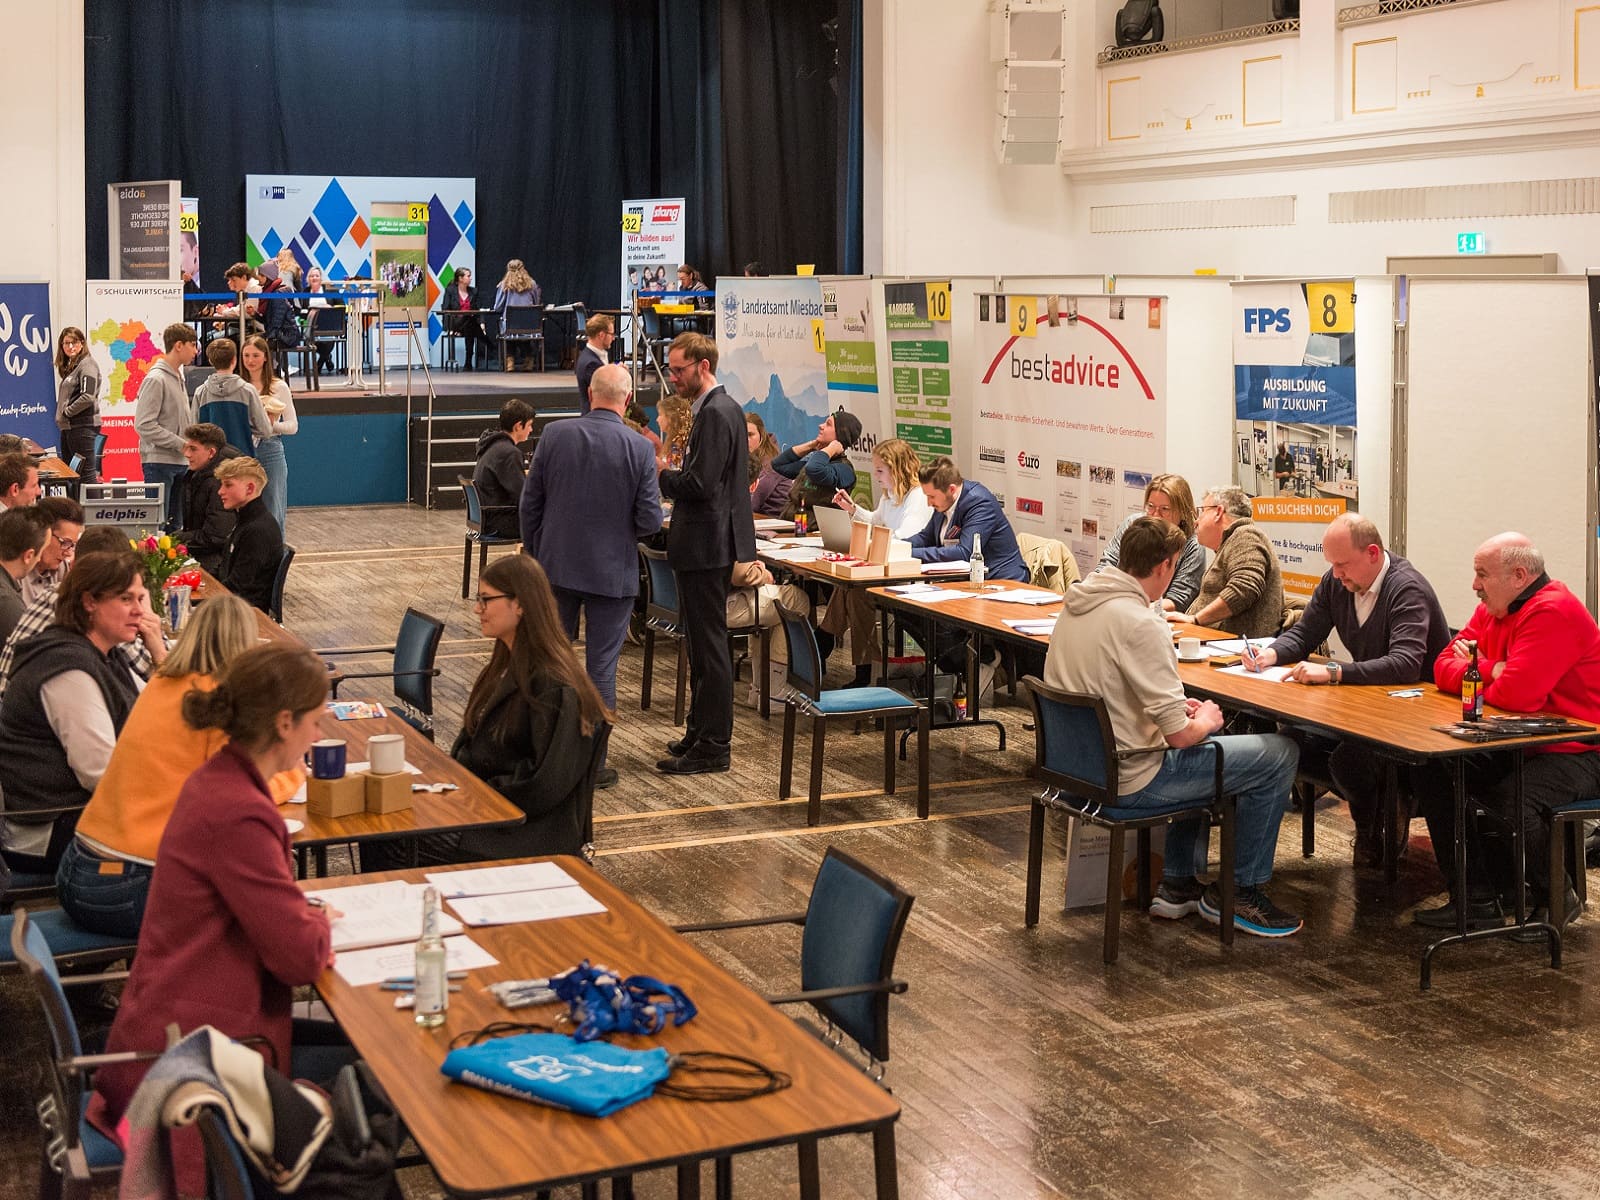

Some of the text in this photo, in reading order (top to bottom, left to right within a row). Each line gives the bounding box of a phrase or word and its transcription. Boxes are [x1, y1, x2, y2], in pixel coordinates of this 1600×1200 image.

[411, 207, 424, 219] 31
[180, 217, 195, 230] 30
[625, 218, 637, 230] 32
[627, 235, 639, 243] Wir
[640, 234, 659, 242] bilden
[741, 299, 789, 315] Landratsamt
[790, 299, 824, 317] Miesbac
[888, 303, 915, 316] KARRIERE
[930, 291, 946, 317] 10
[1322, 294, 1337, 328] 8
[1018, 304, 1027, 332] 9
[1243, 307, 1292, 333] FPS
[815, 326, 825, 349] 1
[1011, 351, 1120, 389] bestadvice
[1263, 379, 1326, 393] AUSBILDUNG
[1263, 397, 1328, 412] MIT ZUKUNFT
[1105, 423, 1118, 435] Über
[850, 432, 877, 453] eich!
[95, 508, 148, 521] delphis
[1257, 503, 1340, 517] WIR SUCHEN DICH!
[1282, 539, 1288, 548] &
